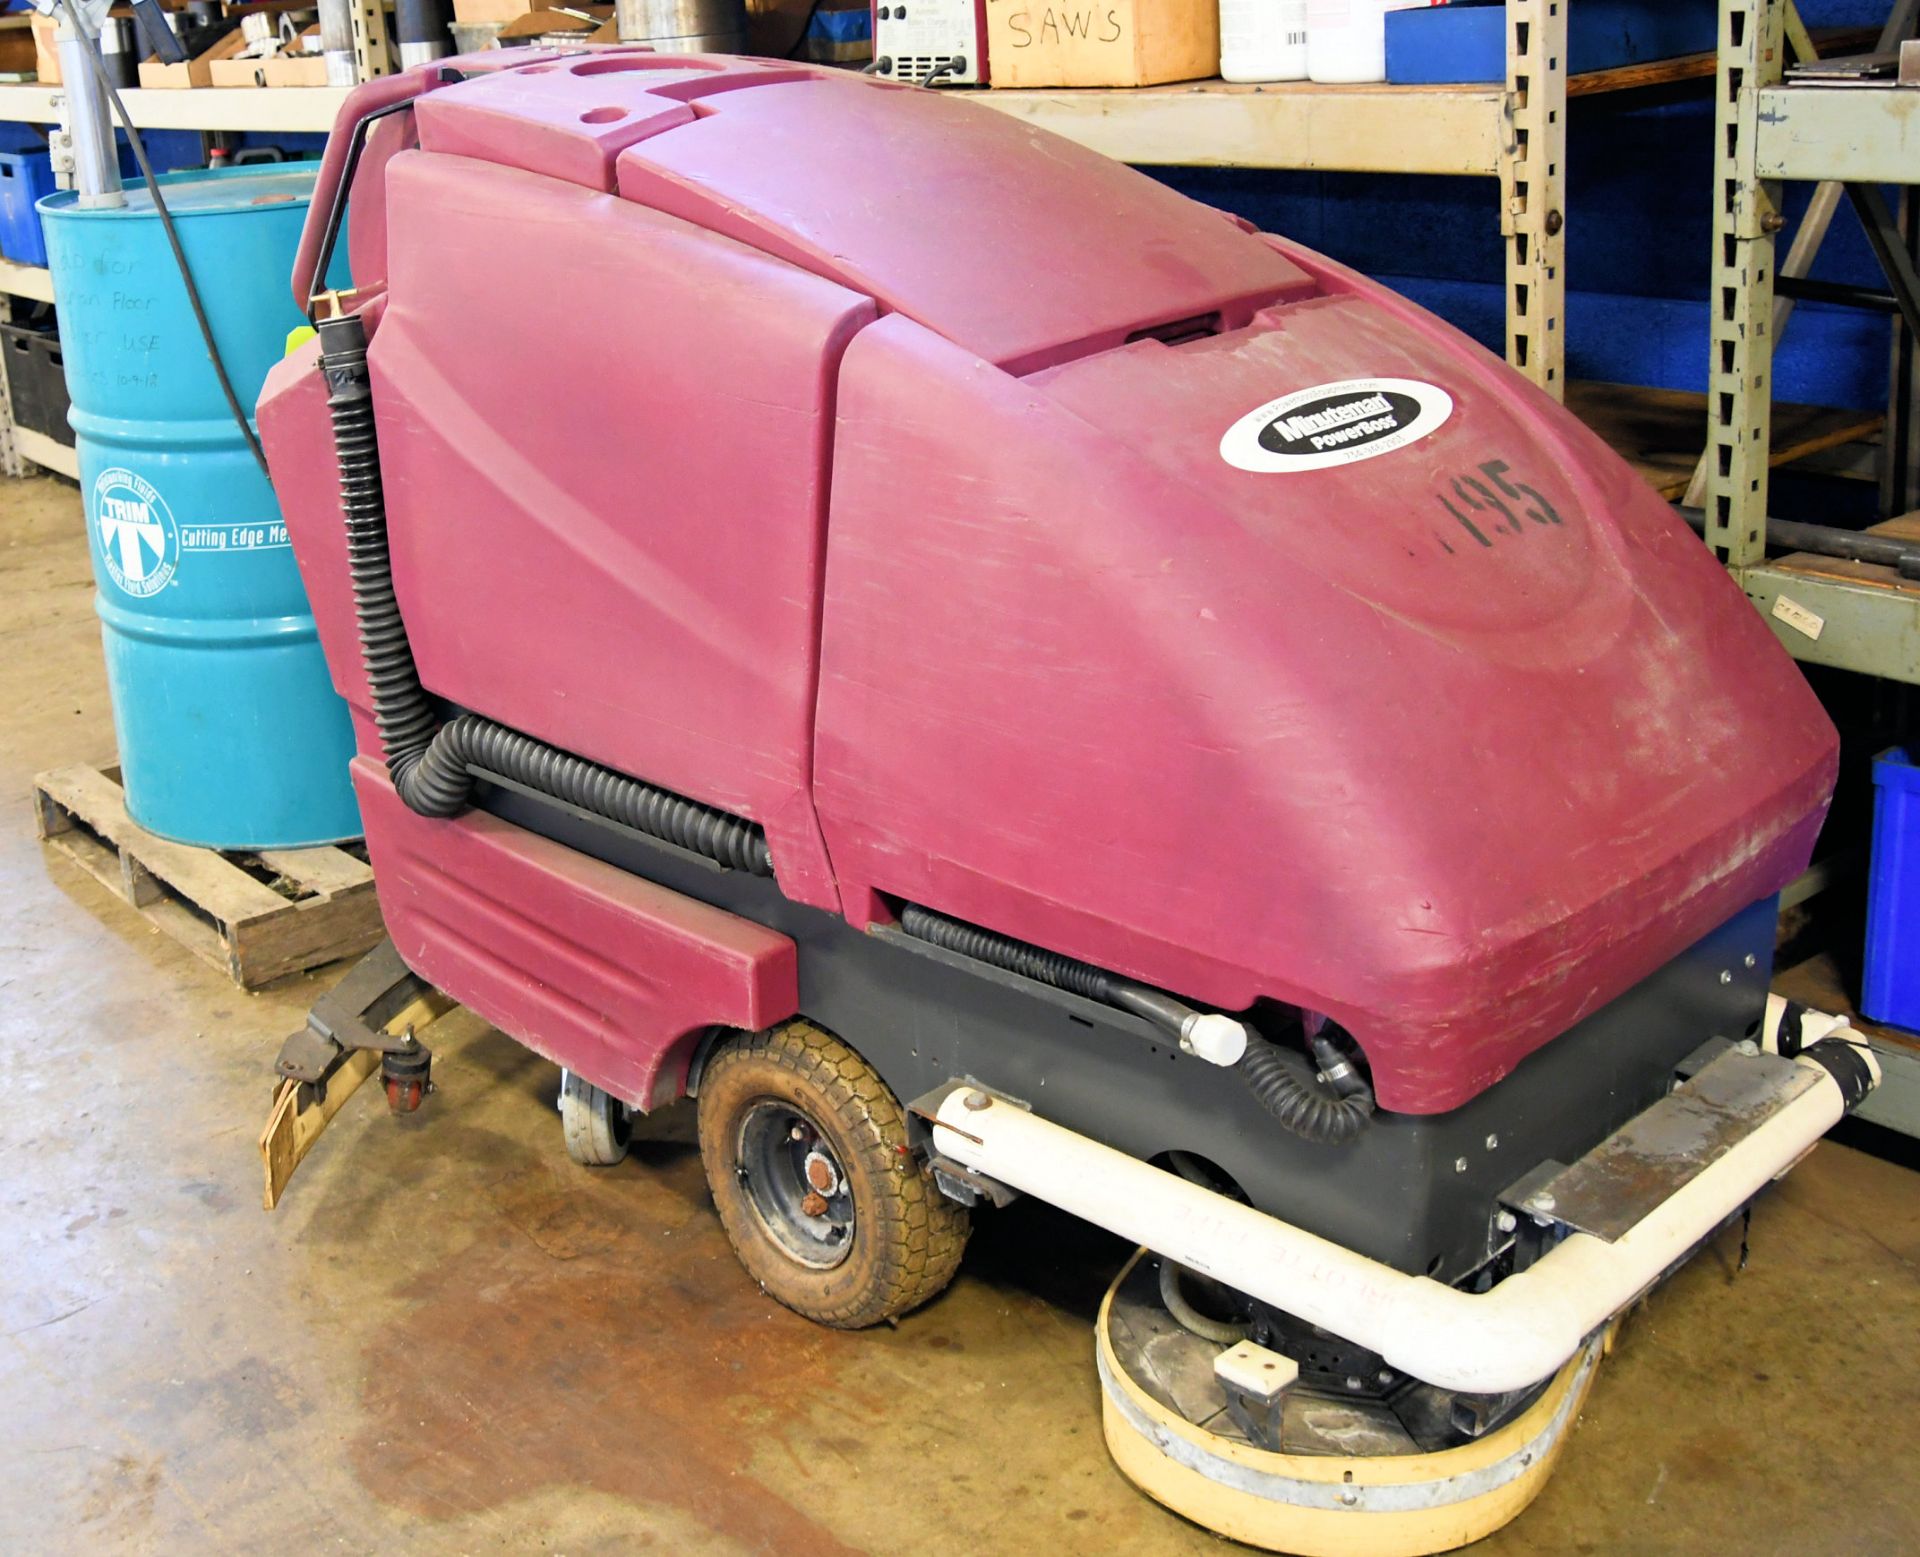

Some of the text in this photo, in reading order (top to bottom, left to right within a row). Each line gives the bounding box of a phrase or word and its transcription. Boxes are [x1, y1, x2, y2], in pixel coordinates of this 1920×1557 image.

[1008, 8, 1121, 48] SAWS
[112, 291, 160, 310] Floor
[123, 333, 160, 353] USE
[1272, 394, 1394, 443] Minuteman
[1310, 414, 1398, 451] PowerBoss
[104, 496, 150, 524] TRIM
[181, 525, 291, 550] Cutting Edge Me
